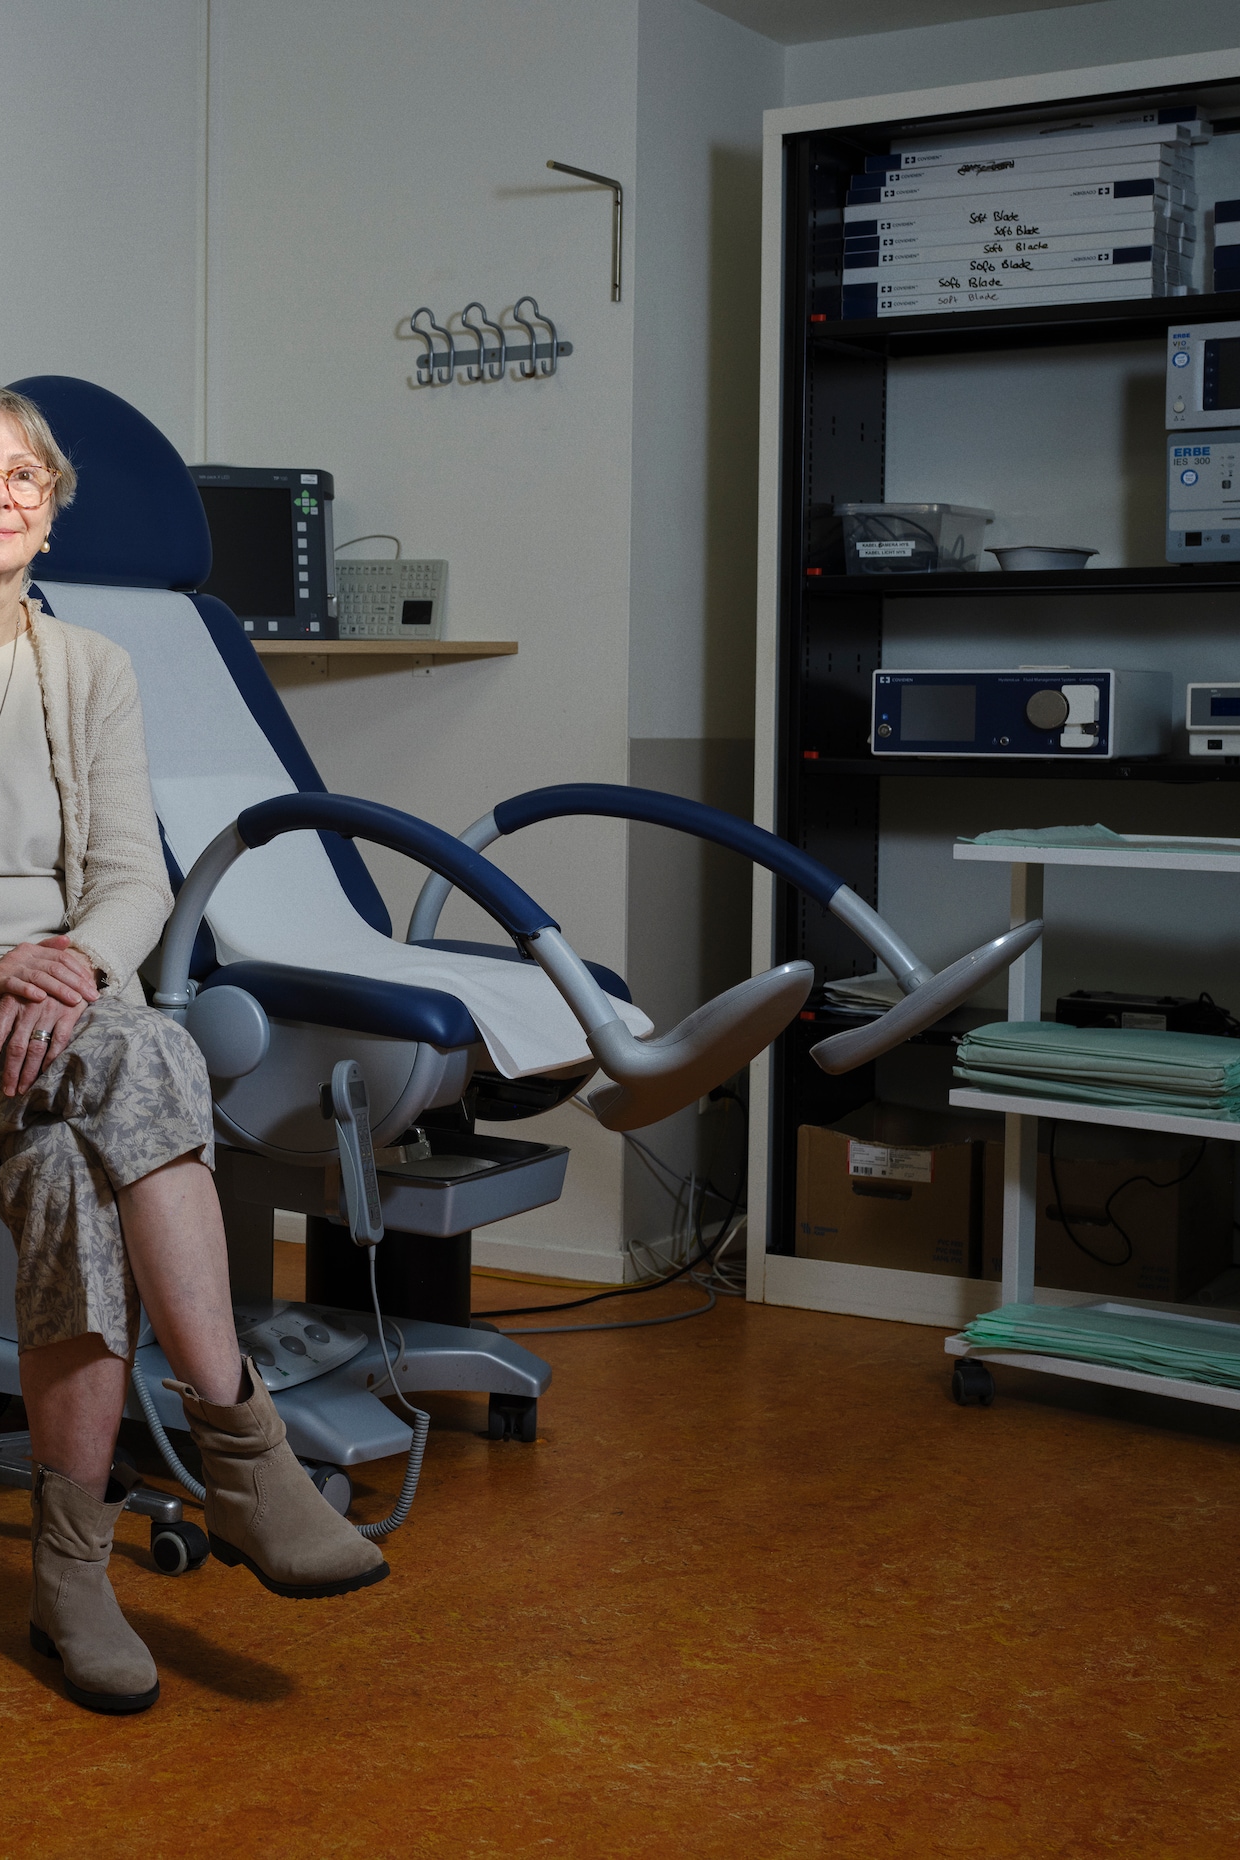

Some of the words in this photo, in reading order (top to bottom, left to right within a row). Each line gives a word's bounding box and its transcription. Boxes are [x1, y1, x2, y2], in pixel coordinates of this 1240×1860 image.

[969, 212, 987, 224] Soft
[993, 210, 1020, 222] Blade
[983, 243, 1003, 254] Soft
[970, 260, 995, 273] Soft
[938, 276, 961, 289] Soft
[968, 276, 1003, 288] Blade
[1174, 446, 1210, 457] ERBE
[1173, 457, 1188, 466] IES
[1194, 457, 1211, 465] 300
